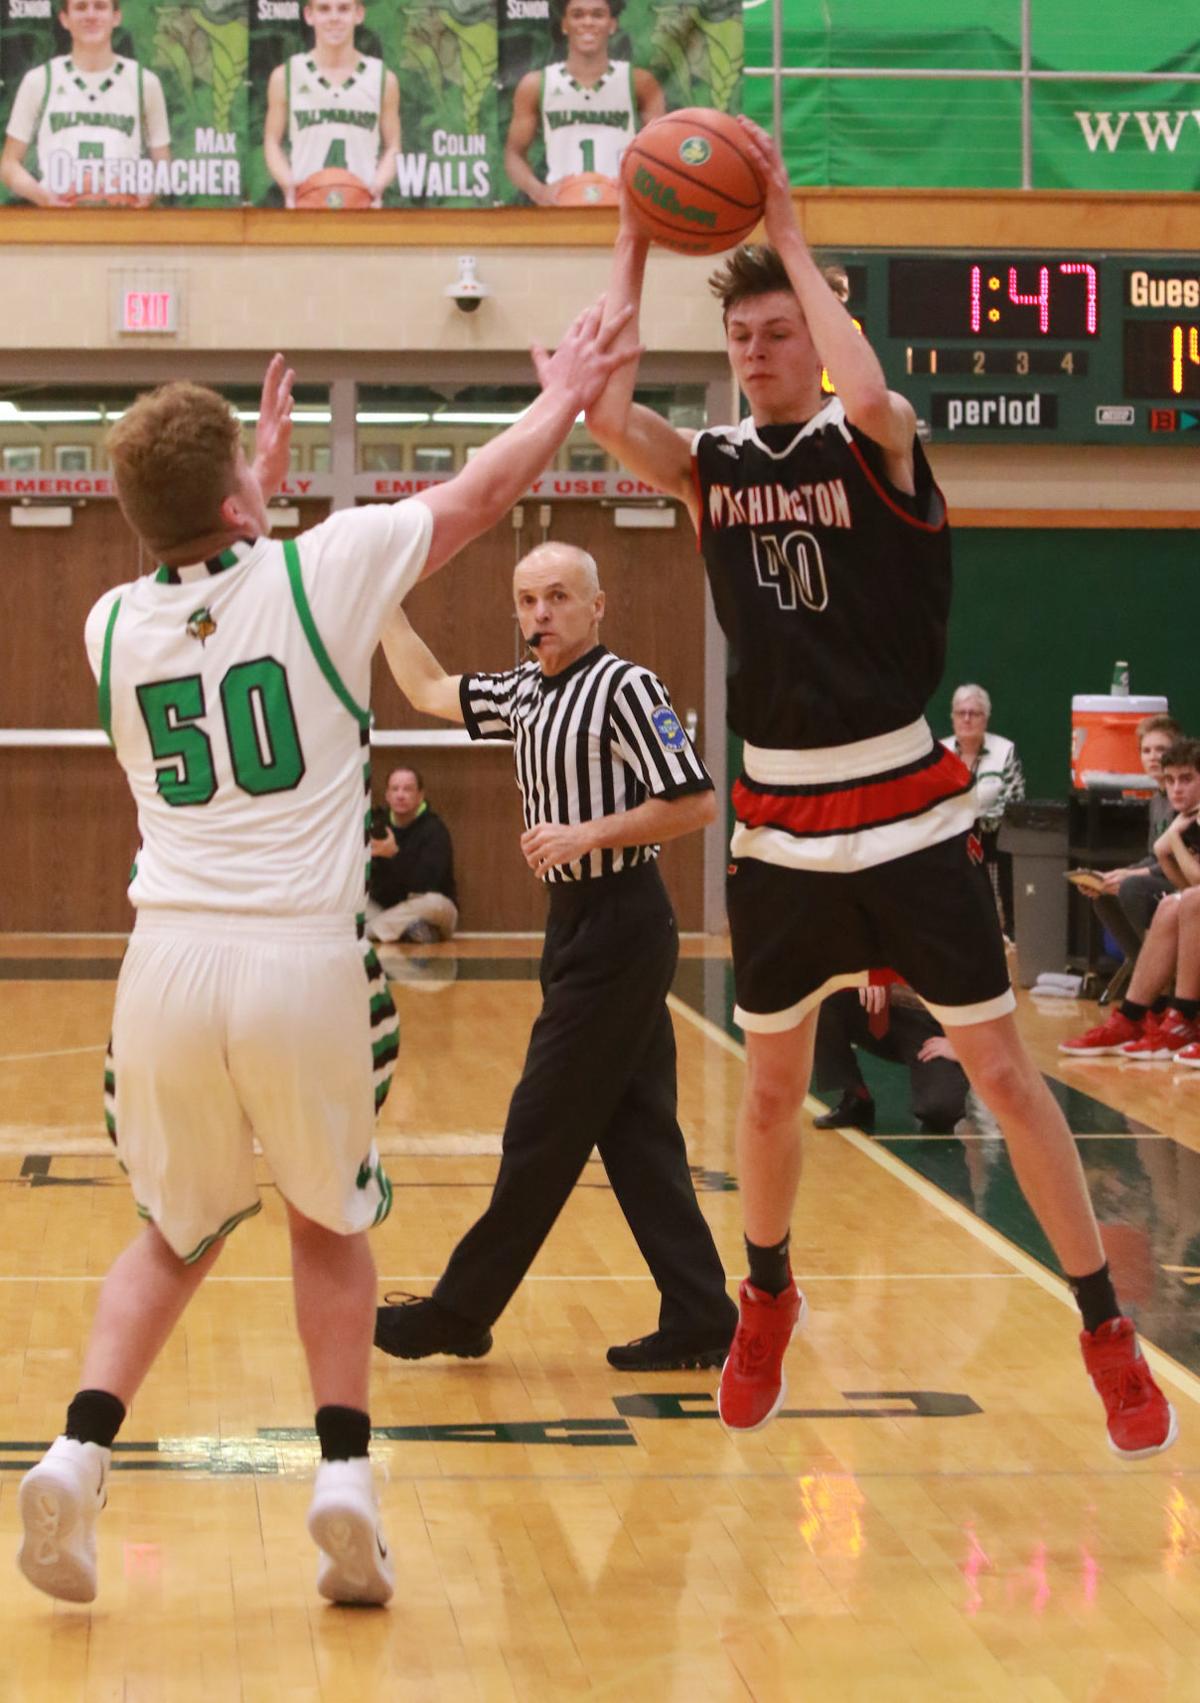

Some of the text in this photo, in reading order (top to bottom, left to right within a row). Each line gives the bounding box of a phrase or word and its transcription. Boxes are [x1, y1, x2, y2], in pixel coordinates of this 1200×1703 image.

[395, 153, 491, 198] WALLS
[970, 264, 1097, 334] 1:47
[1130, 271, 1200, 308] Gues
[126, 292, 170, 328] EXIT
[973, 351, 986, 375] 2
[1016, 351, 1030, 375] 3
[1060, 351, 1074, 376] 4
[948, 393, 1041, 431] period
[0, 479, 110, 494] EMERGE
[554, 480, 606, 495] USE
[616, 480, 666, 495] ON
[751, 529, 829, 613] 40
[135, 654, 307, 807] 50
